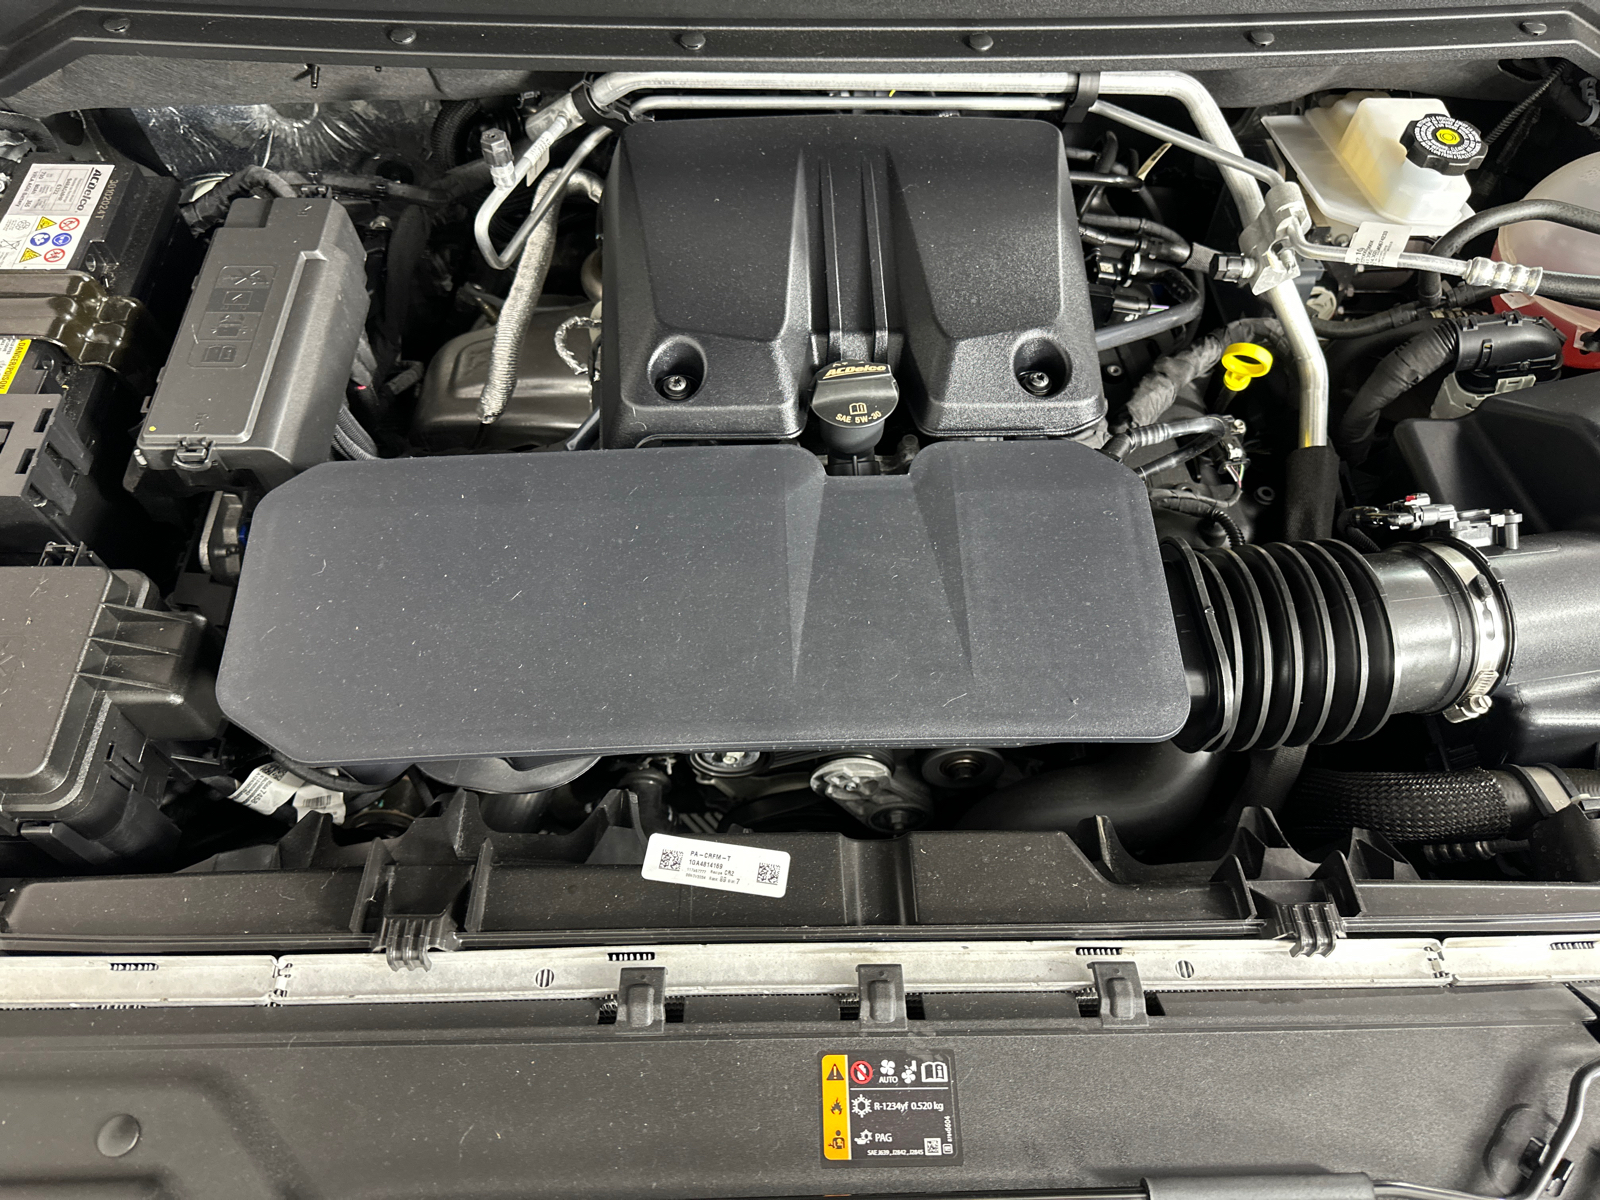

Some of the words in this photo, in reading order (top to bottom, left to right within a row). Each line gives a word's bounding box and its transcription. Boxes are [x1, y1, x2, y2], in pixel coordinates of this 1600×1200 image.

[76, 169, 102, 211] ACDelco
[825, 365, 887, 377] ACDelco
[836, 413, 852, 423] SAE
[855, 411, 882, 424] 5W-30
[879, 1076, 898, 1084] AUTO
[874, 1102, 909, 1111] R-1234yf
[911, 1102, 933, 1110] 0.520
[933, 1102, 944, 1111] kg
[875, 1133, 893, 1142] PAG
